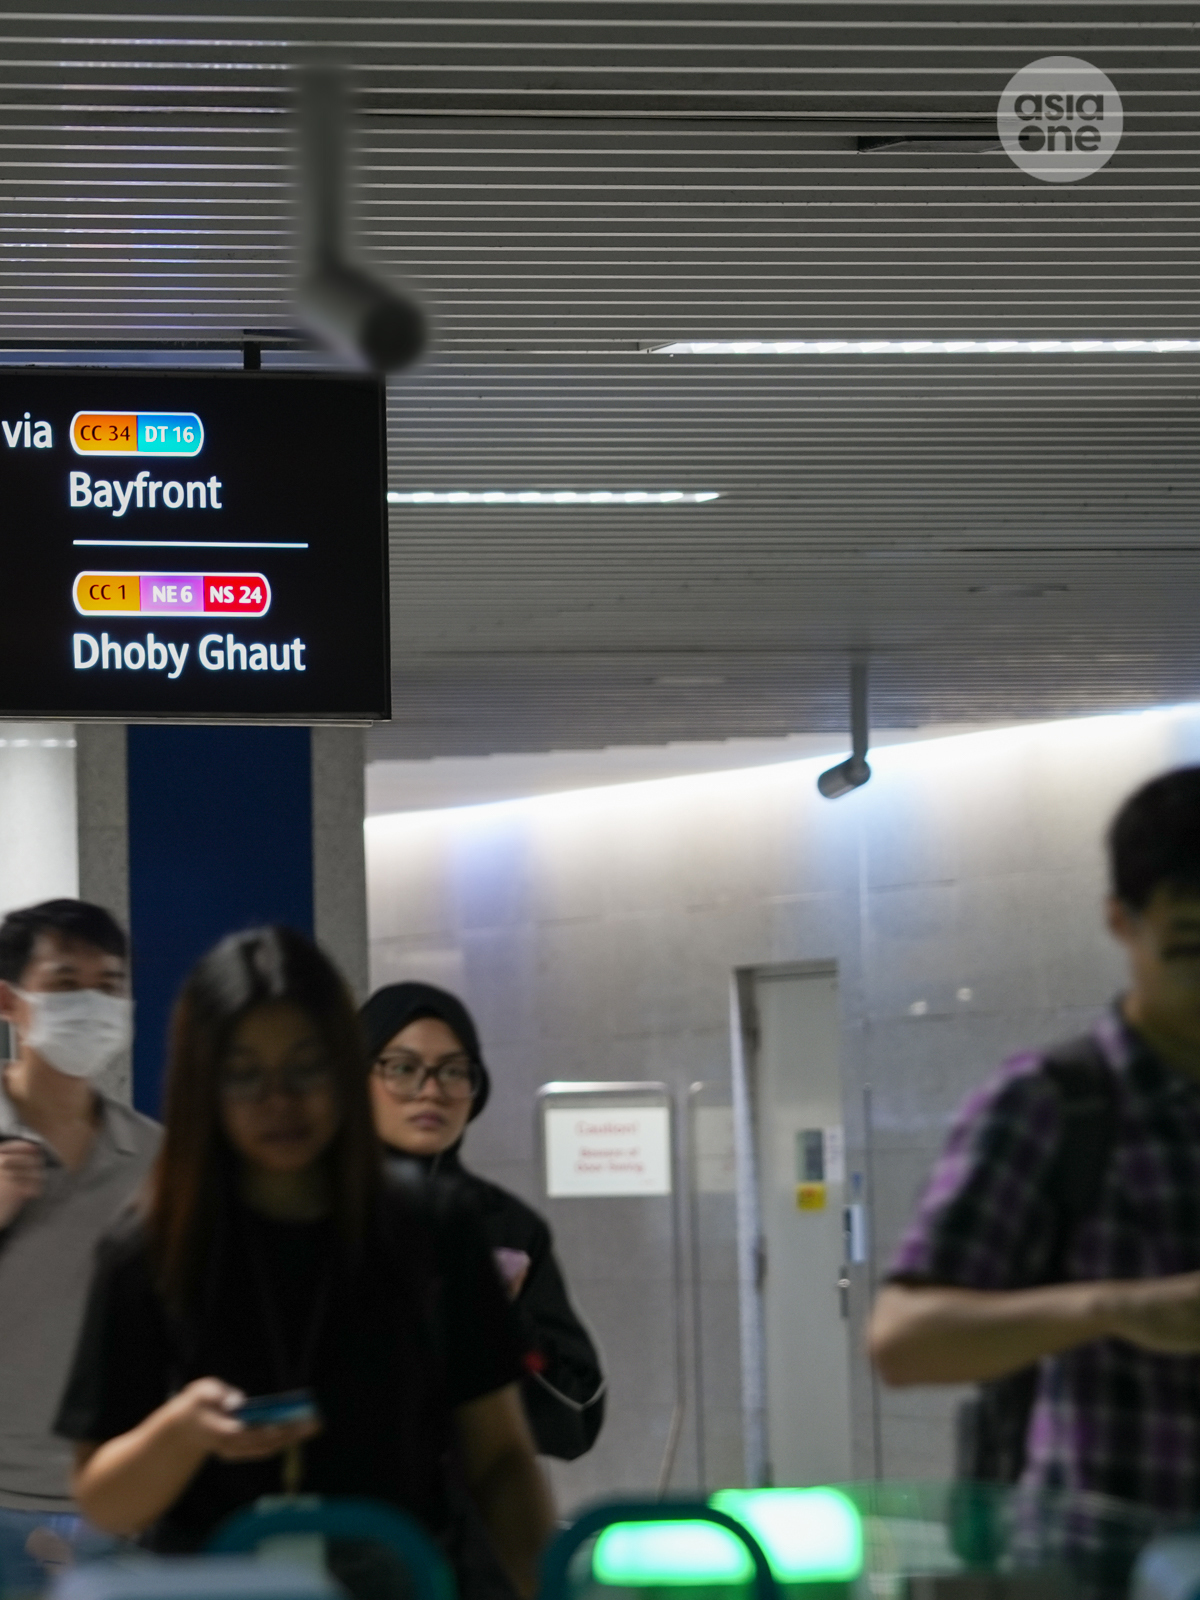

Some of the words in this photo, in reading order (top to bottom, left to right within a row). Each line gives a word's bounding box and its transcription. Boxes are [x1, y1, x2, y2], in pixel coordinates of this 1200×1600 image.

[1, 412, 53, 449] via
[80, 425, 102, 441] CC
[108, 425, 131, 441] 34
[145, 425, 169, 443] DT
[172, 426, 195, 443] 16
[69, 470, 223, 517] Bayfront
[89, 584, 111, 600] CC
[118, 584, 126, 600] 1
[152, 585, 178, 603] NE
[180, 585, 193, 603] 6
[209, 586, 234, 603] NS
[238, 586, 263, 603] 24
[73, 632, 190, 679] Dhoby
[198, 633, 306, 671] Ghaut
